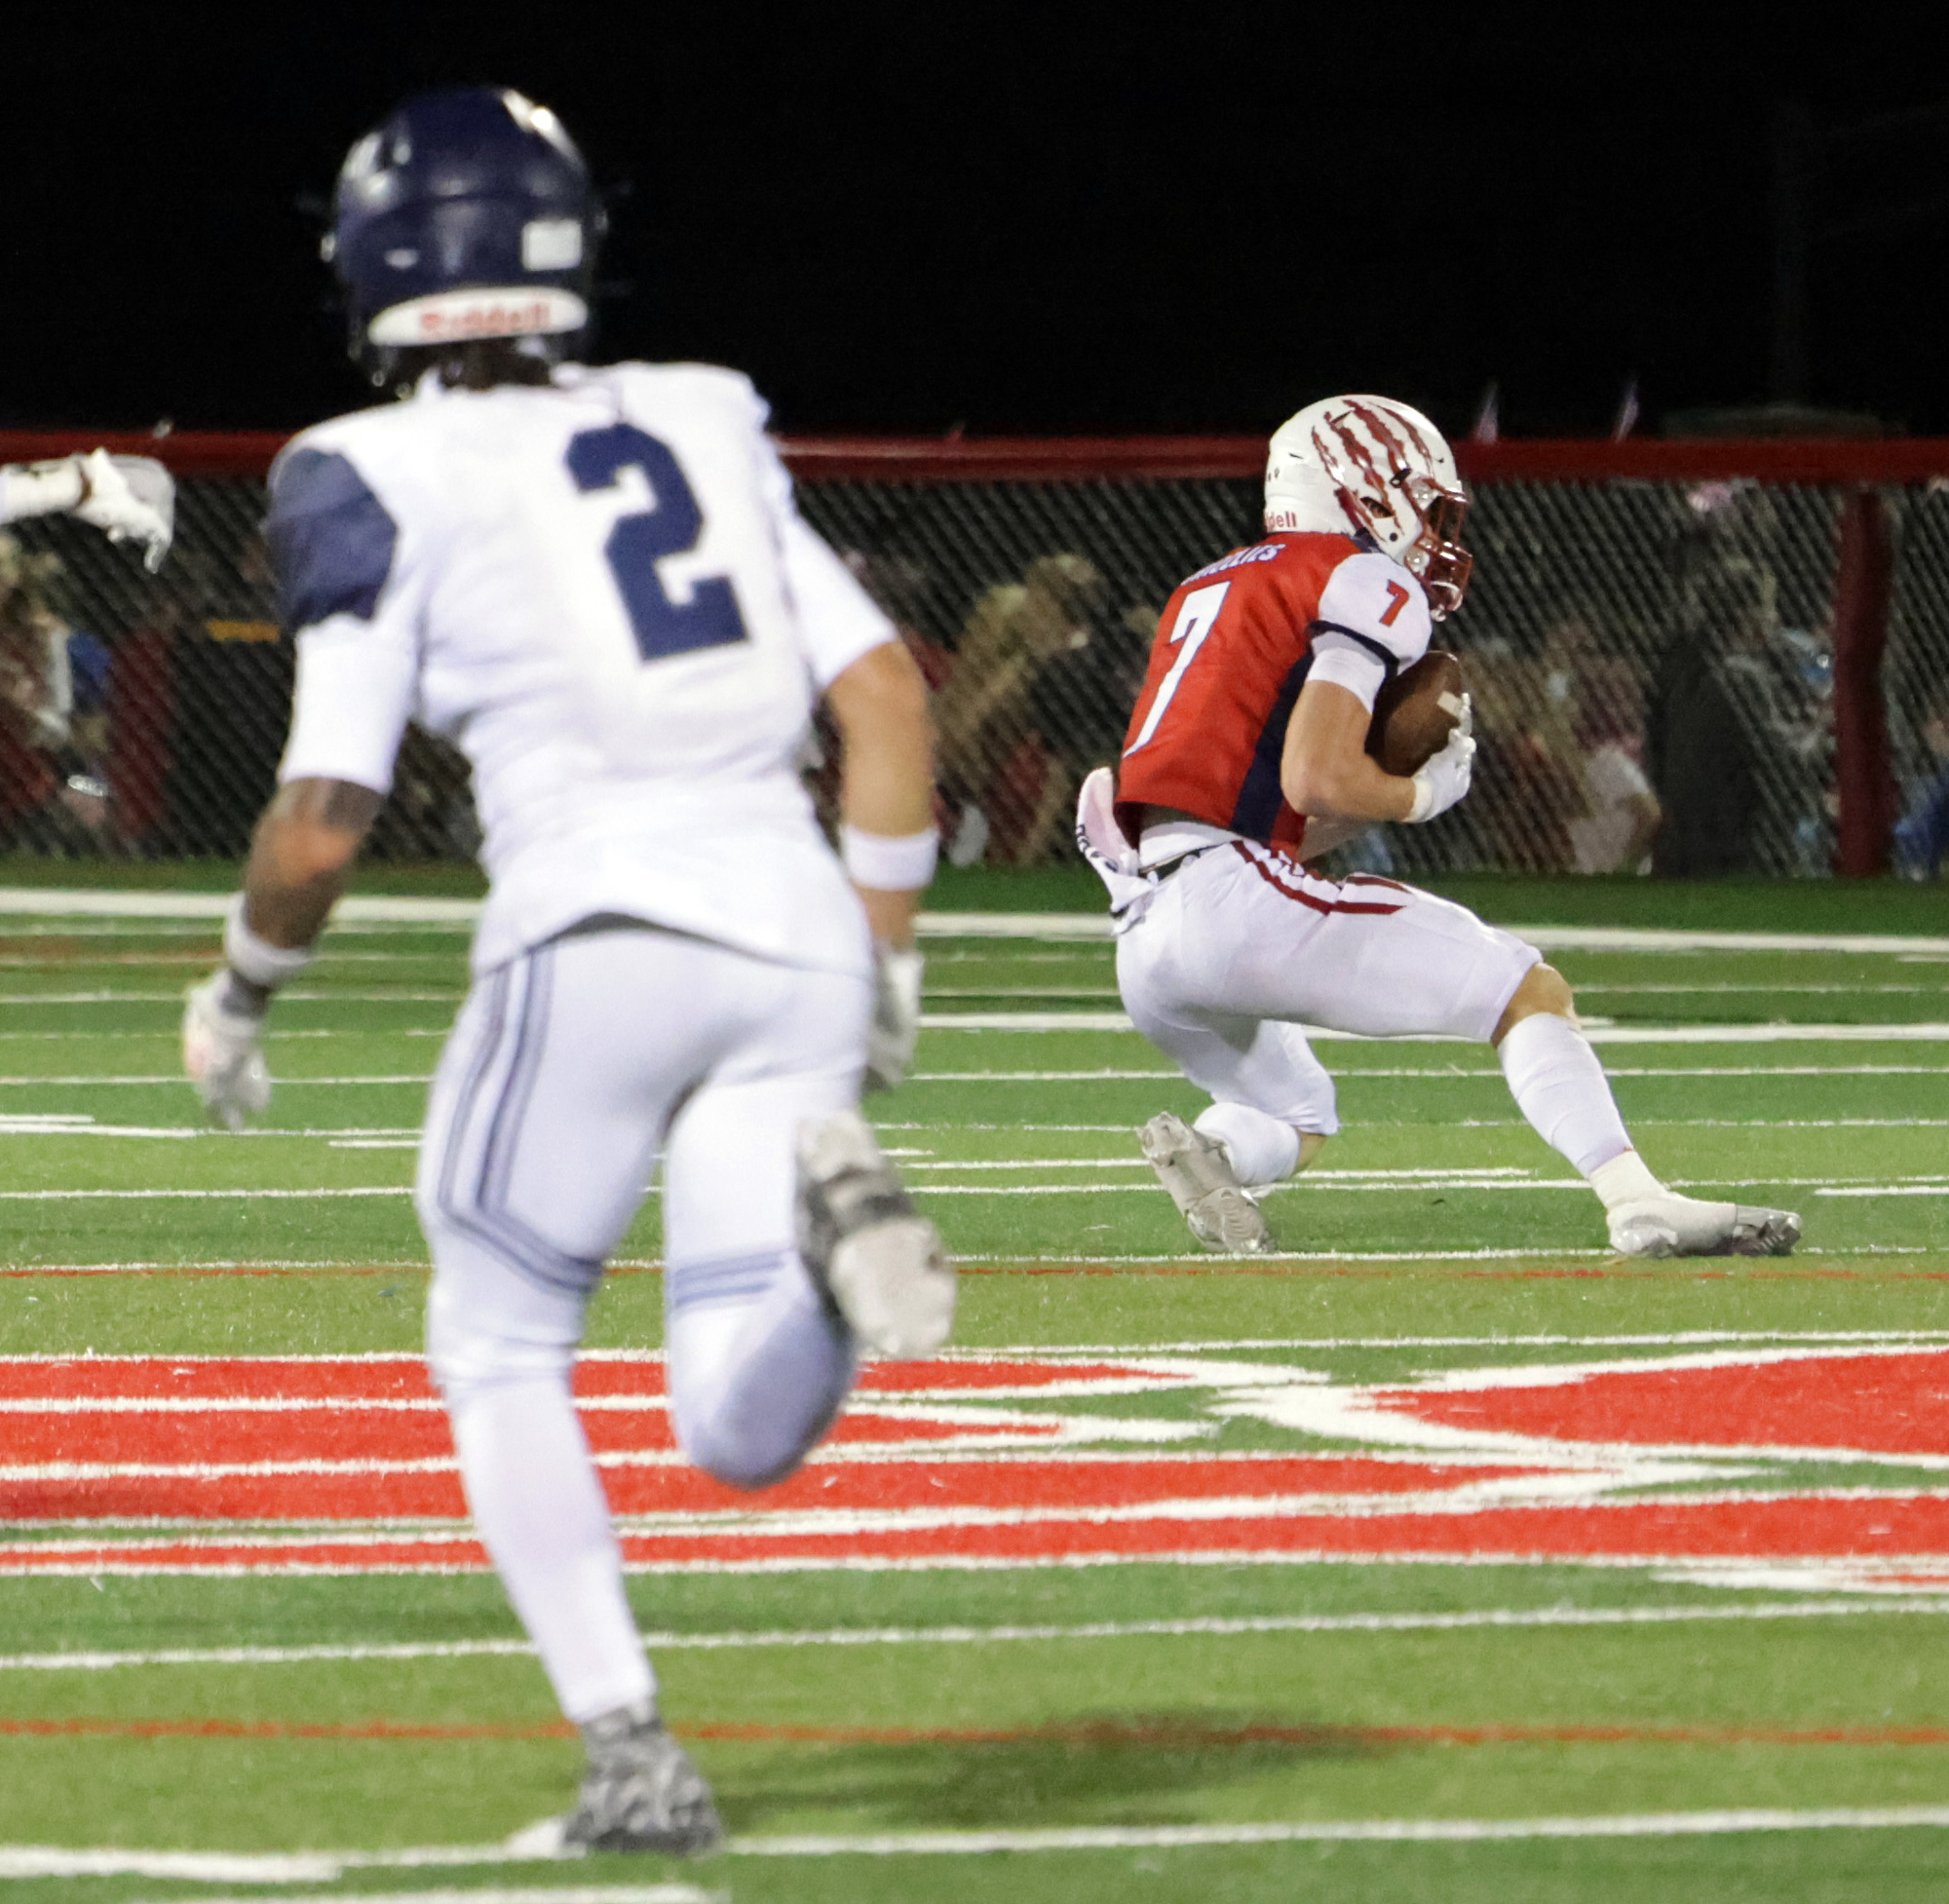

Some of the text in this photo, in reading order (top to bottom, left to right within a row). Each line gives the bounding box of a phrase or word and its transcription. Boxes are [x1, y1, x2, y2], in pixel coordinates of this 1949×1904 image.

[566, 423, 749, 661] 2
[1379, 579, 1410, 628] 7
[1123, 581, 1232, 758] 7
